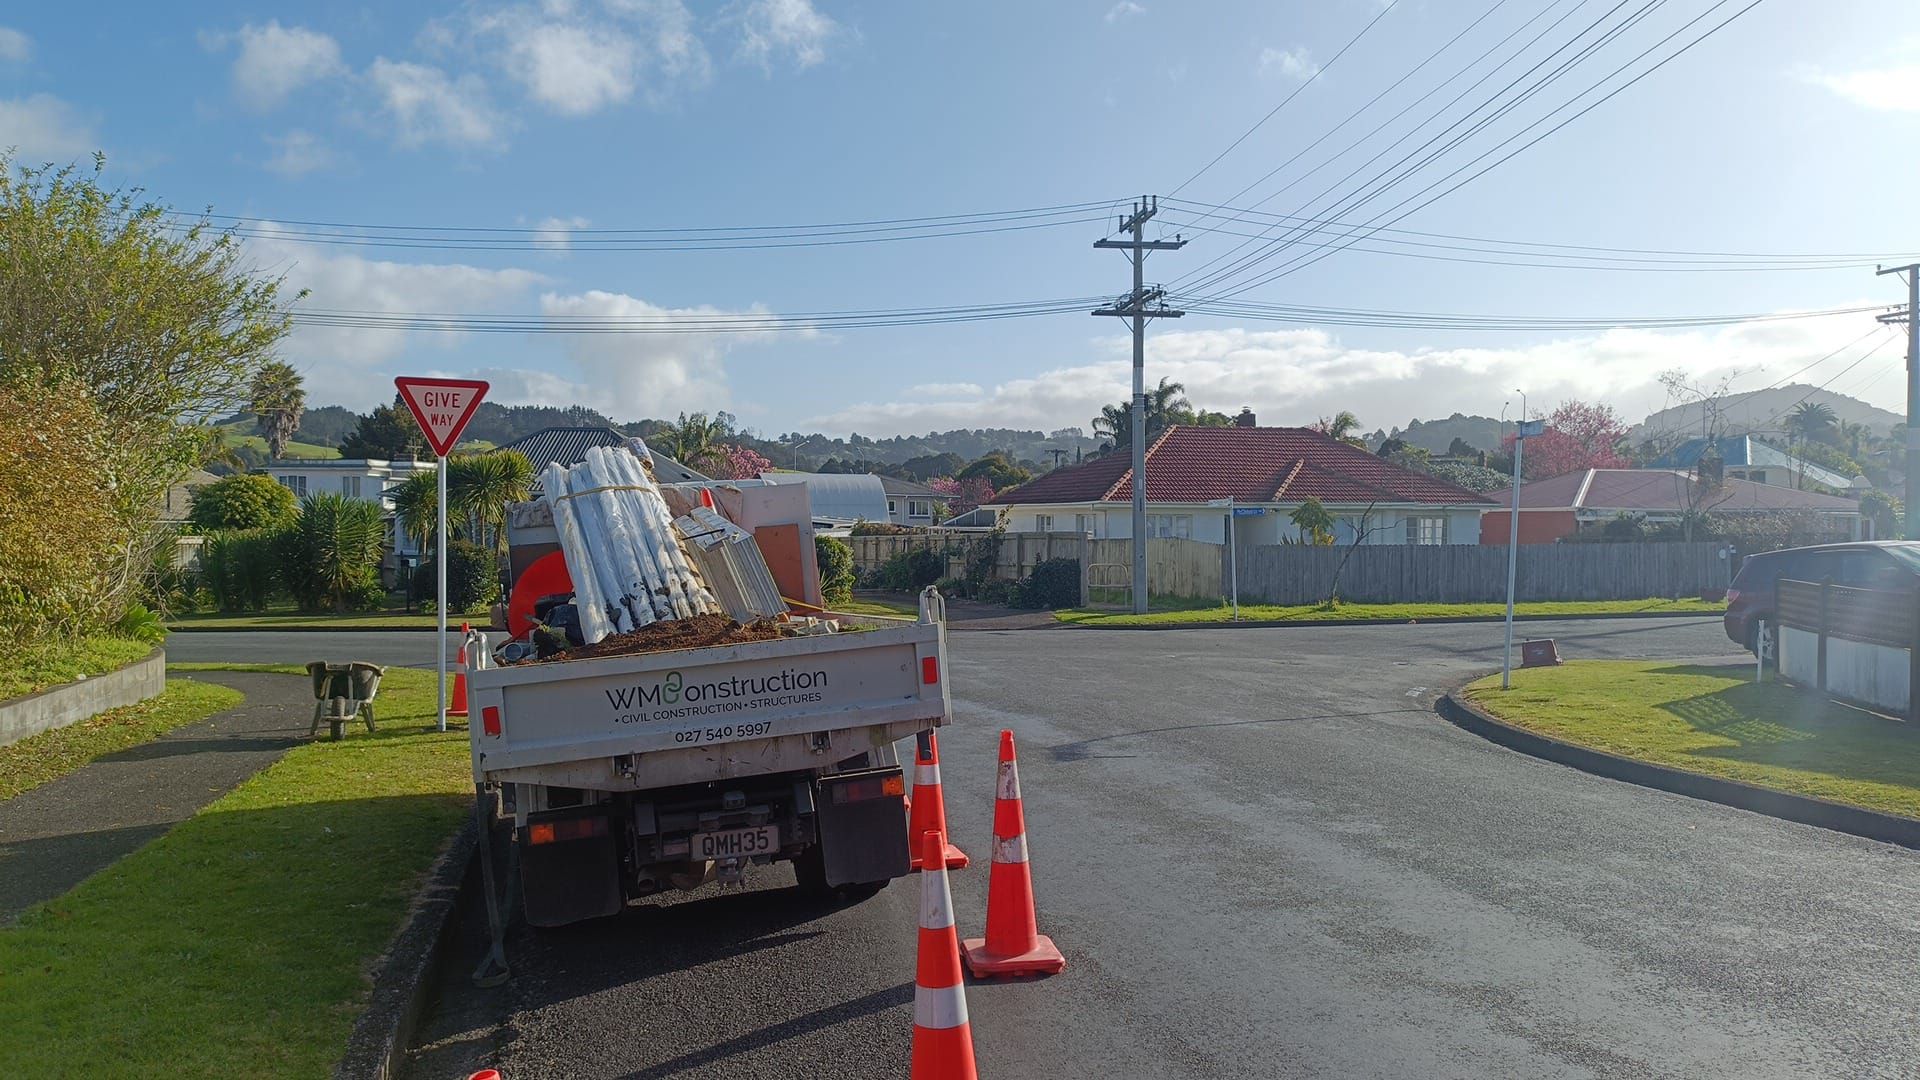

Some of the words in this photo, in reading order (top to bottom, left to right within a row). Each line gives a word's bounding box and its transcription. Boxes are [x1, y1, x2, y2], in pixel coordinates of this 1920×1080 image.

[424, 391, 461, 408] GIVE
[430, 413, 454, 426] WAY
[621, 713, 651, 724] CIVIL
[653, 702, 742, 720] CONSTRUCTION
[750, 692, 822, 709] STRUCTURES
[675, 729, 702, 743] 027
[706, 726, 733, 741] 540
[737, 721, 772, 737] 5997
[702, 829, 769, 856] QMH35
